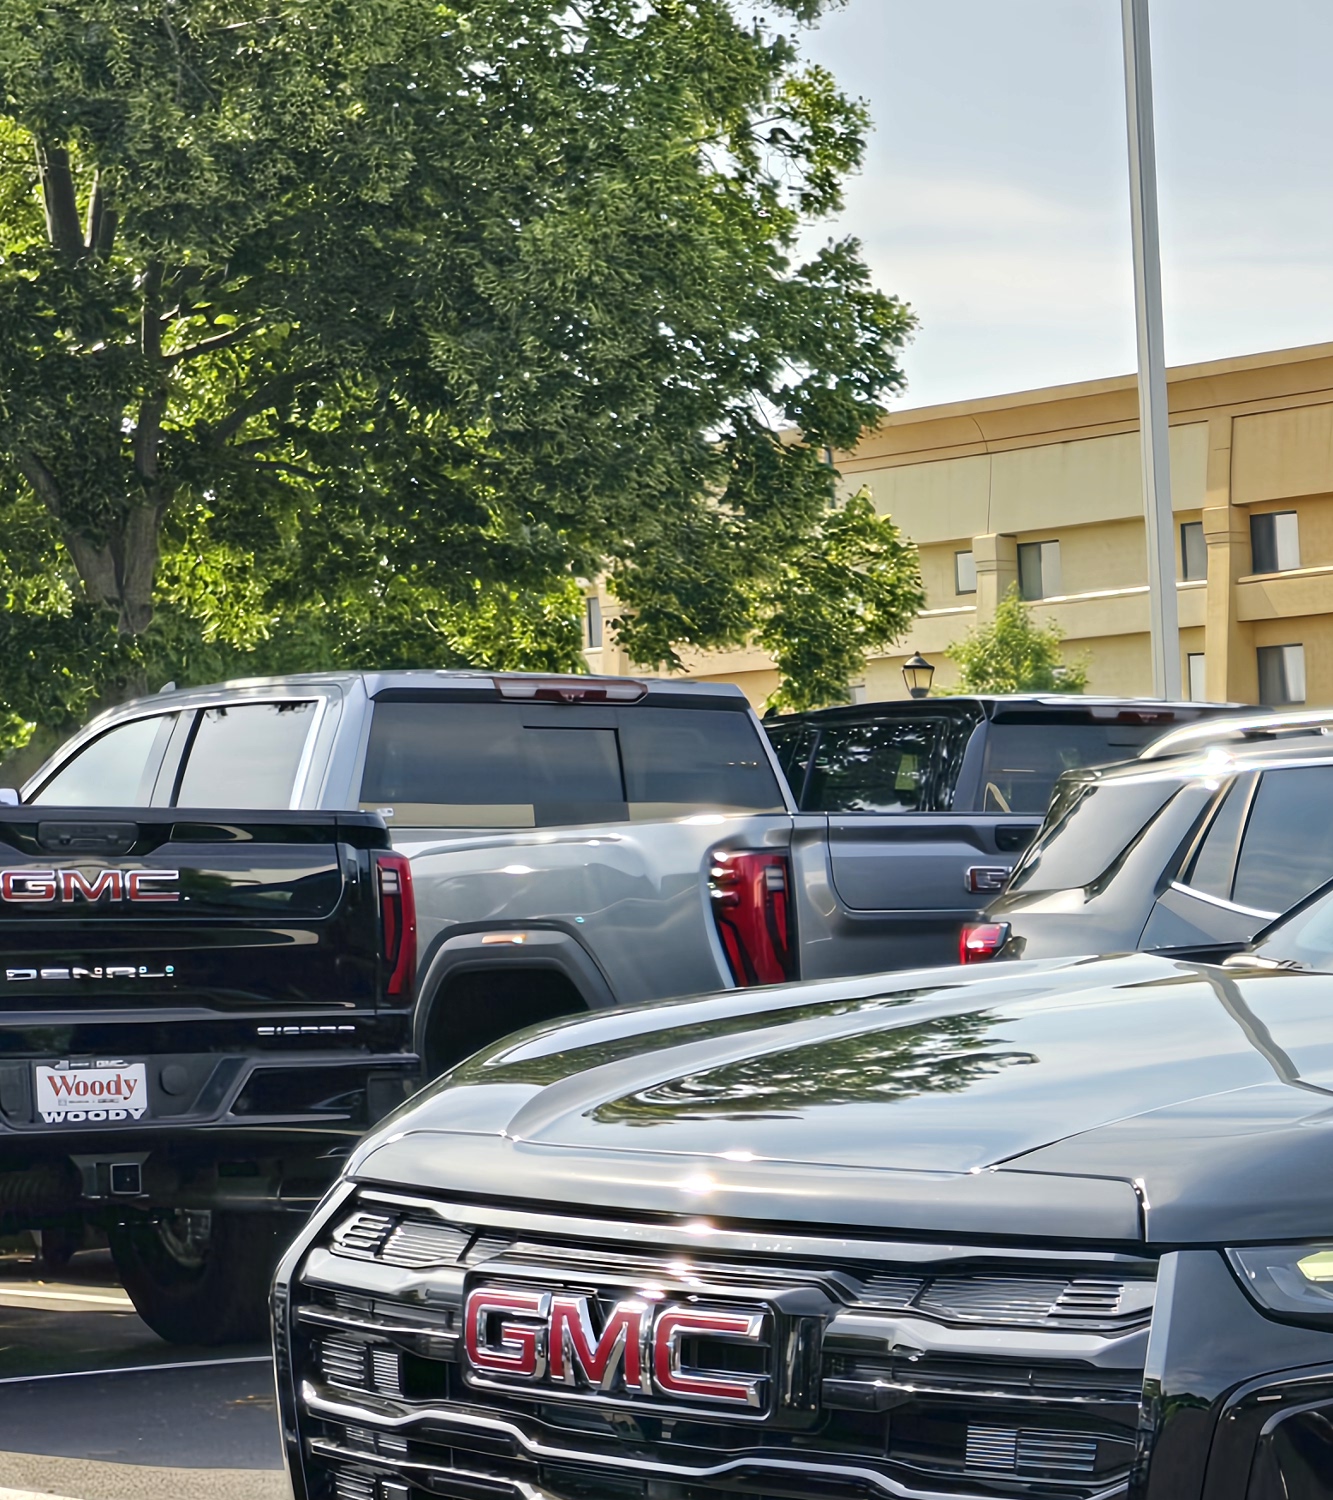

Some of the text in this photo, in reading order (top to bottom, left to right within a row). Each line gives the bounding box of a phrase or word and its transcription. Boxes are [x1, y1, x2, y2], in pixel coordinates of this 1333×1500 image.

[0, 869, 180, 902] GMC
[47, 1074, 138, 1101] Woody
[41, 1108, 147, 1123] WOODY
[466, 1287, 764, 1408] GMC
